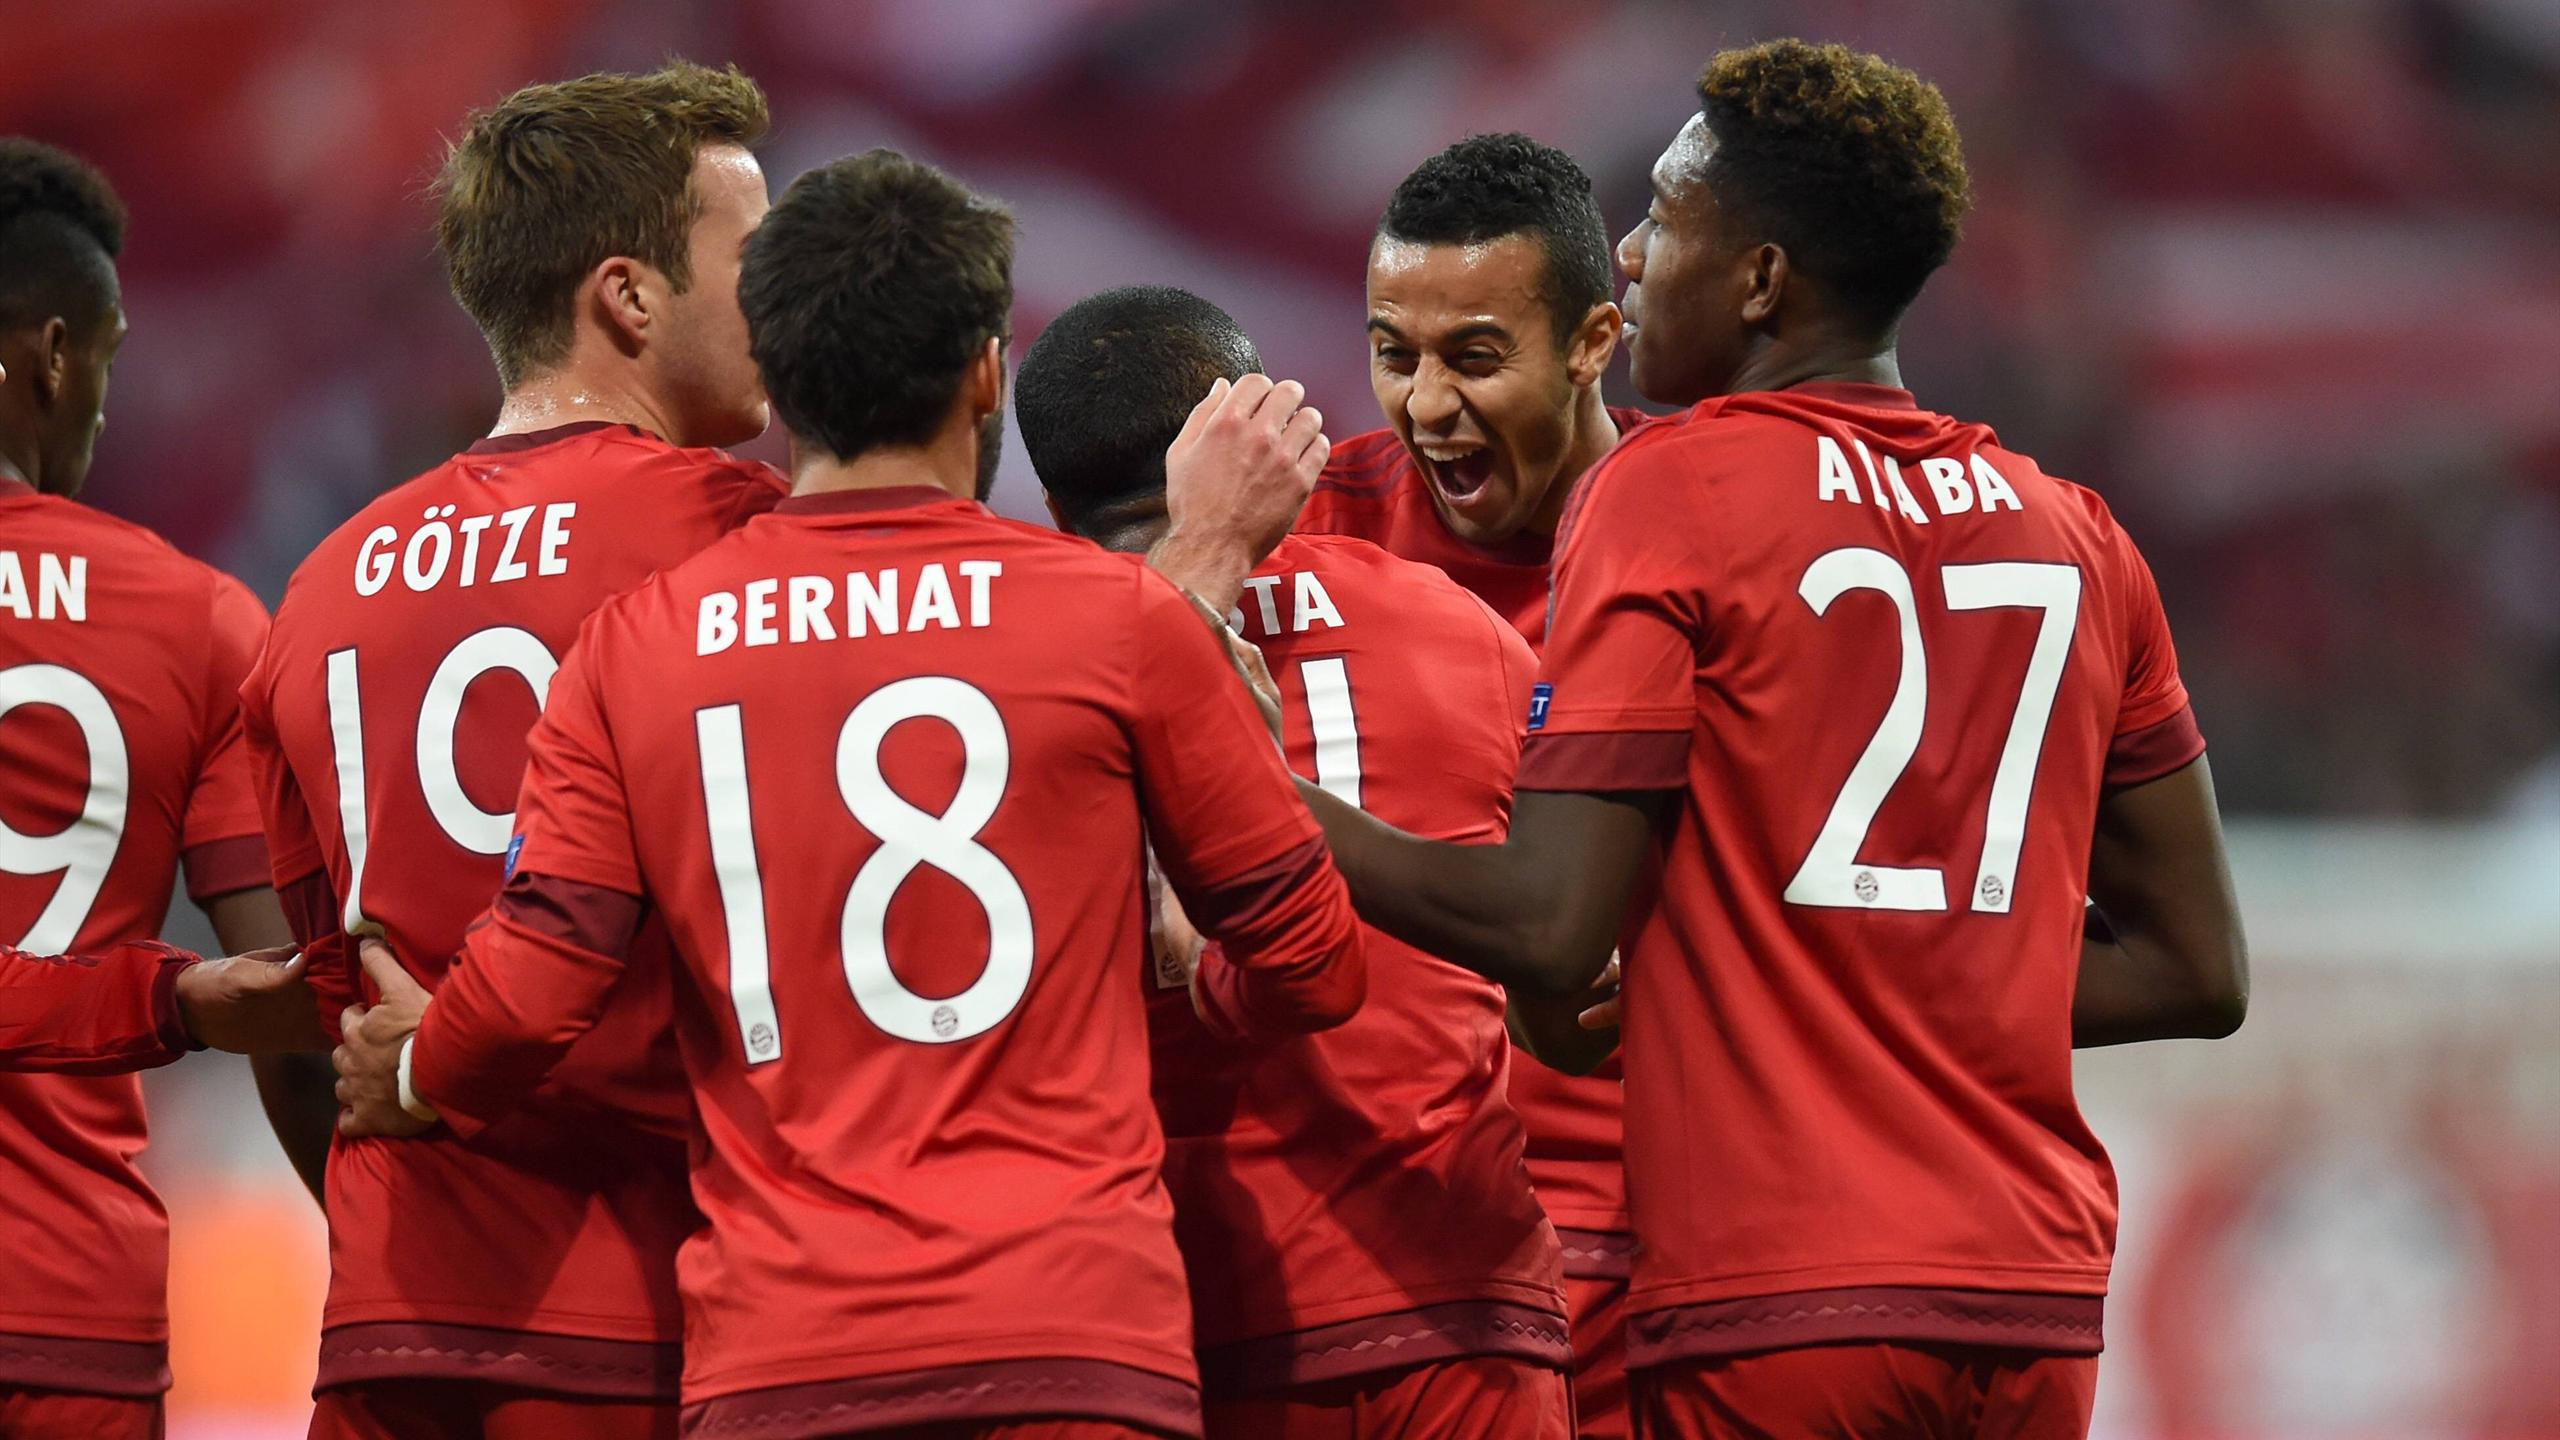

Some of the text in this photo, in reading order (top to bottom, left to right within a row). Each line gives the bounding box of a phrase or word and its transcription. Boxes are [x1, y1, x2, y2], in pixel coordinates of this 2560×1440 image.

[1817, 435, 2024, 524] ALABA
[354, 502, 577, 597] GÖTZE
[696, 560, 1002, 657] BERNAT
[1228, 571, 1345, 635] TA
[1784, 547, 2082, 914] 27
[695, 676, 1034, 1064] 18
